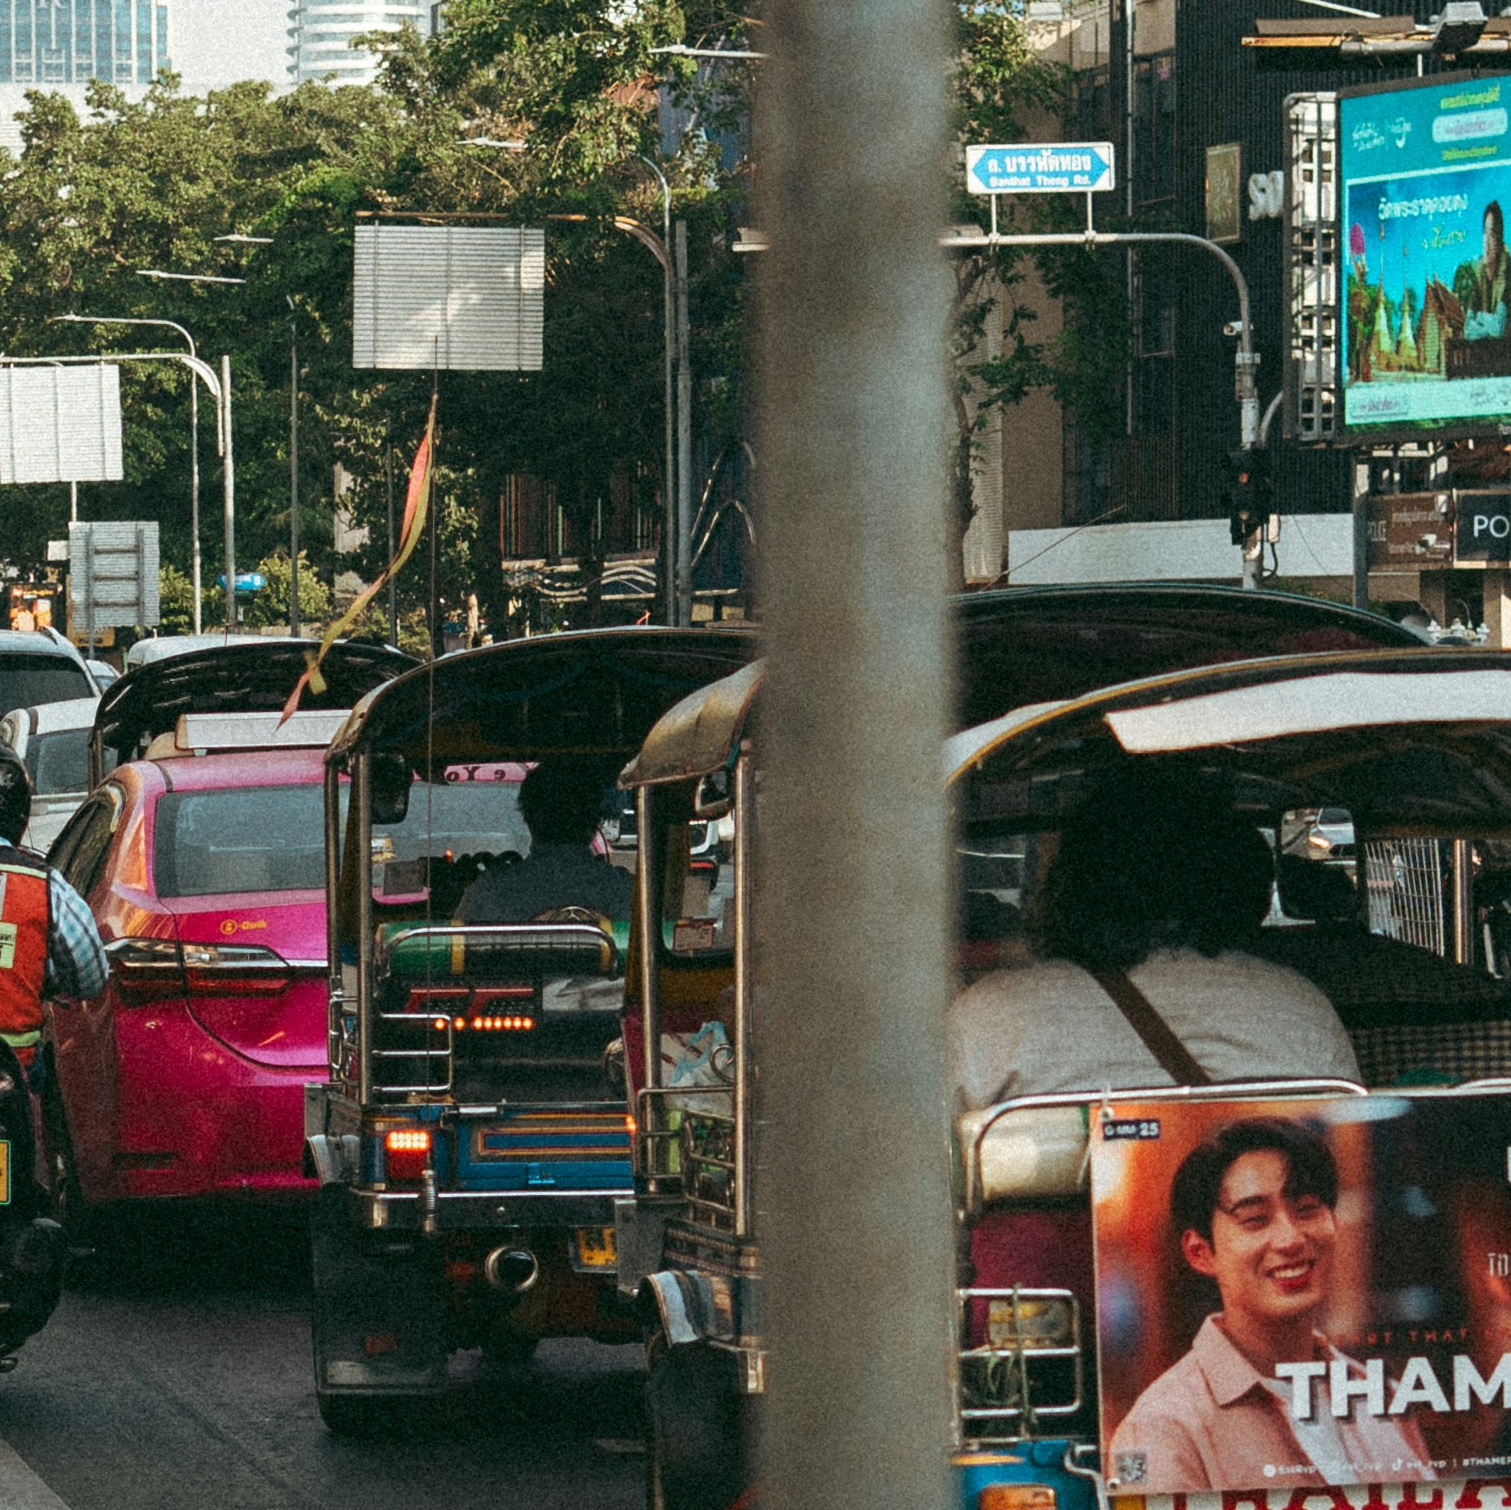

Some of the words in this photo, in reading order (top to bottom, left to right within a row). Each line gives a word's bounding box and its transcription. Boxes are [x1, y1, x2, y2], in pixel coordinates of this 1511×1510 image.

[1004, 148, 1092, 173] บรรทัดทอง
[990, 176, 1031, 187] Banthat
[1036, 175, 1069, 187] Thong
[1073, 174, 1090, 185] Rd.
[1473, 515, 1510, 538] PO
[1139, 1122, 1159, 1137] 25
